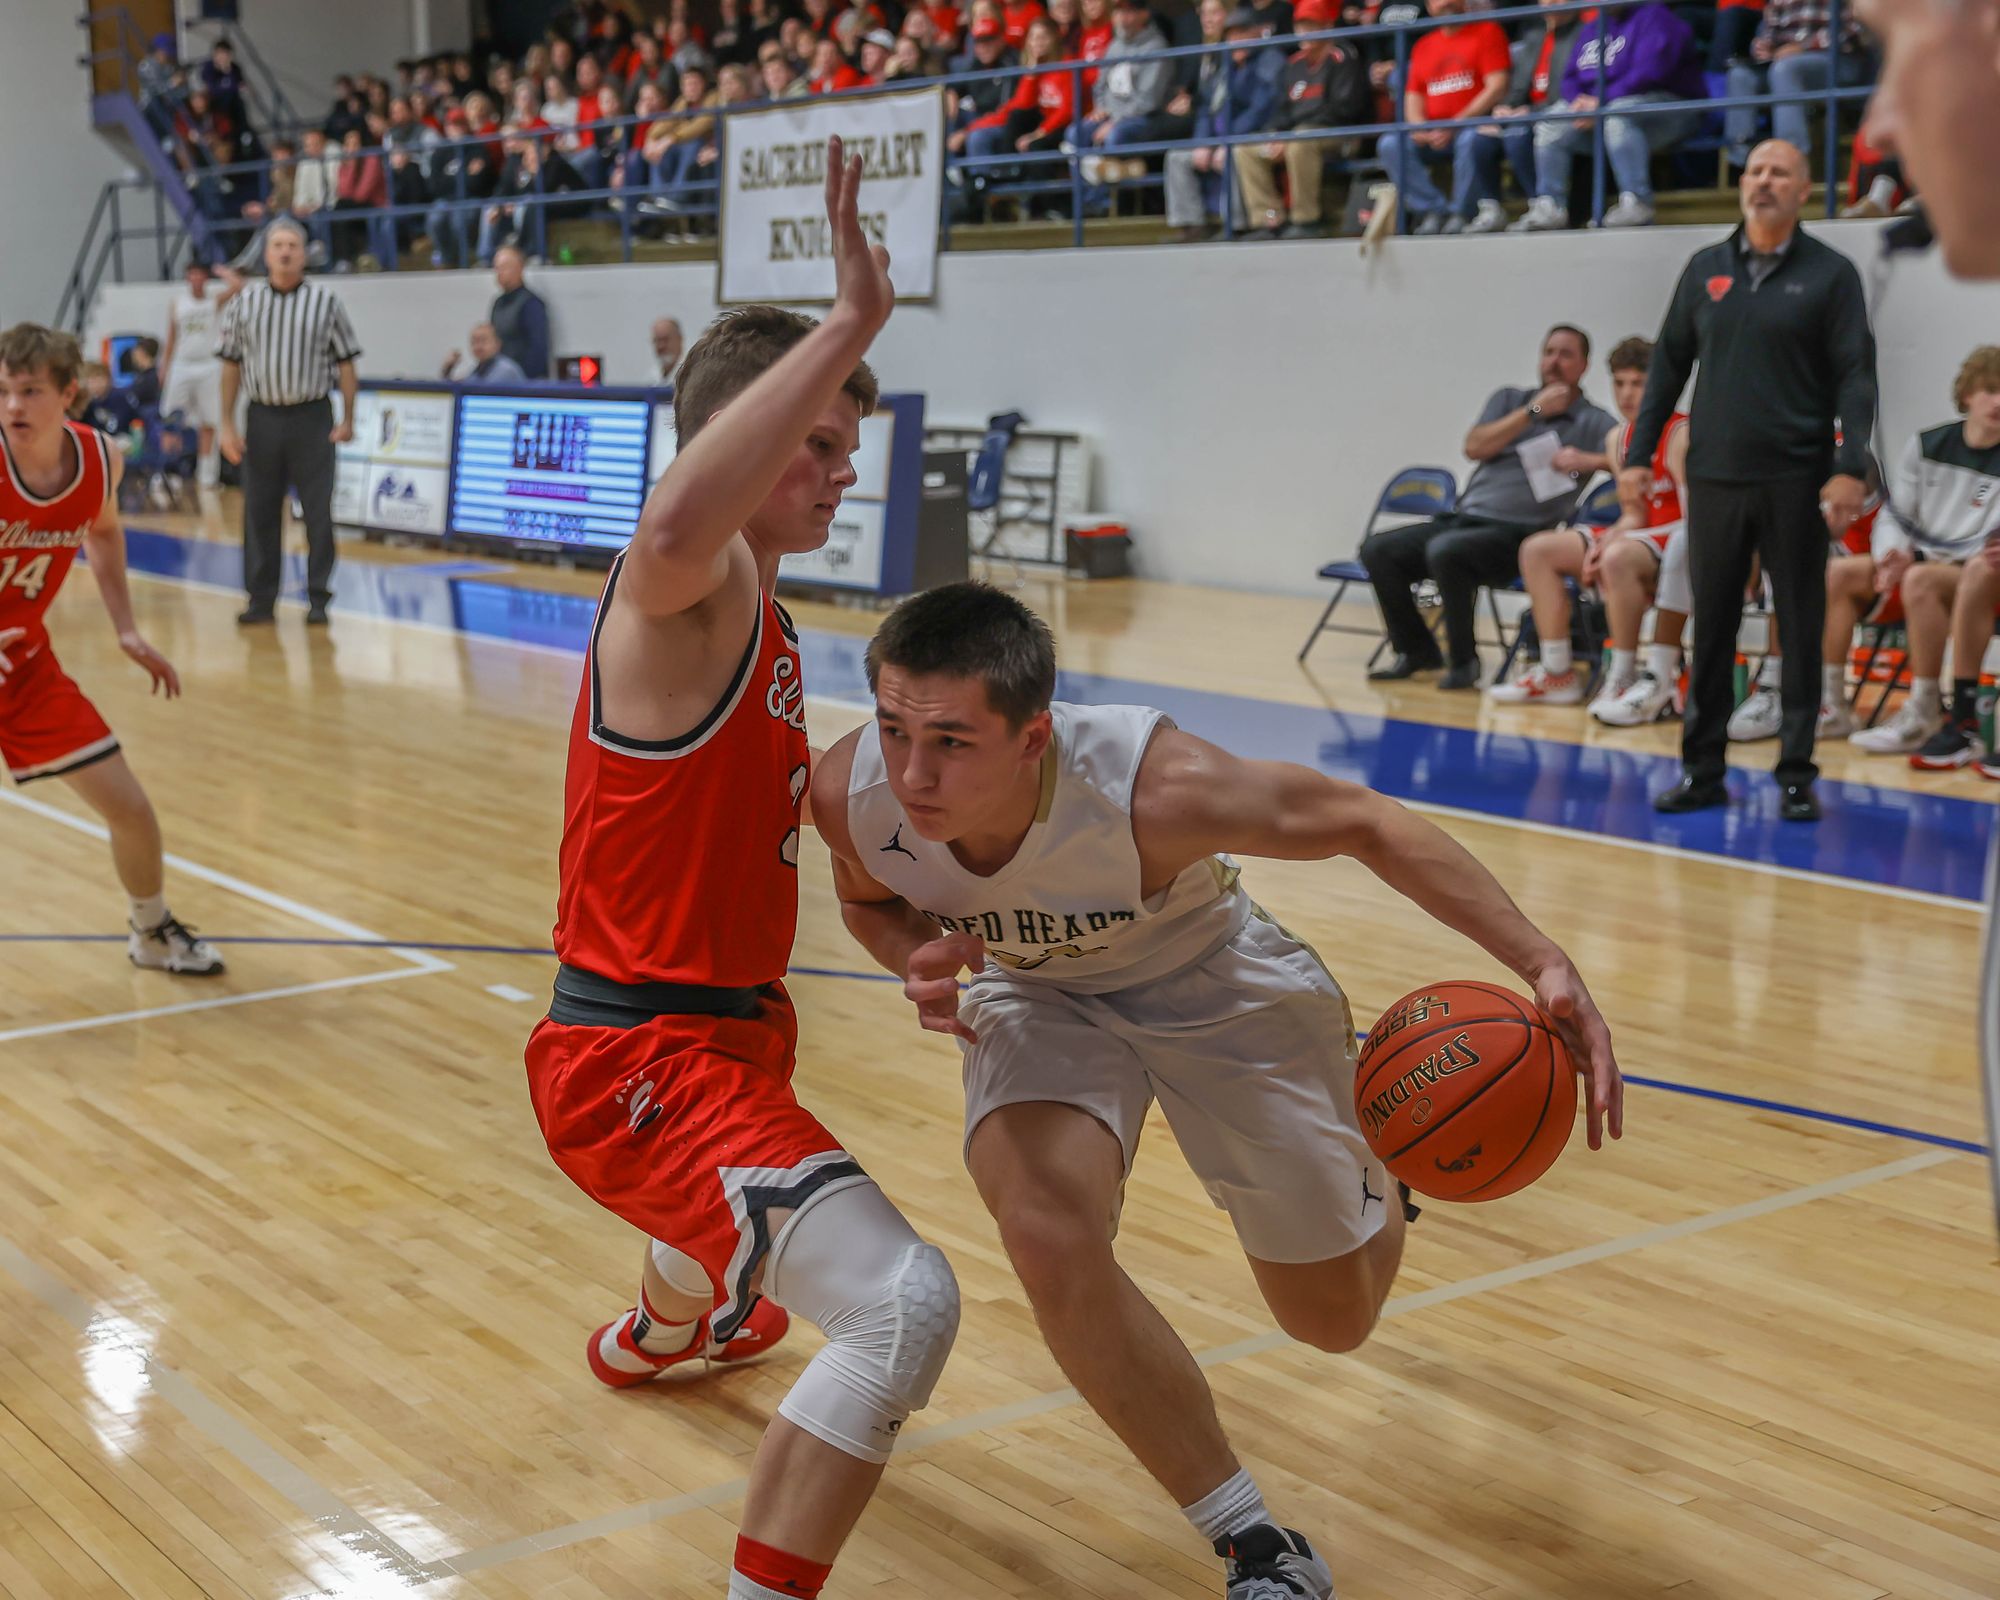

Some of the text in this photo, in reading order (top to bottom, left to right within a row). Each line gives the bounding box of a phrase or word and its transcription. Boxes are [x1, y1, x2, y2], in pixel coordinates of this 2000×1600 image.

[0, 518, 92, 549] llsworth
[0, 553, 53, 600] 14
[1361, 1031, 1481, 1141] SPALDING
